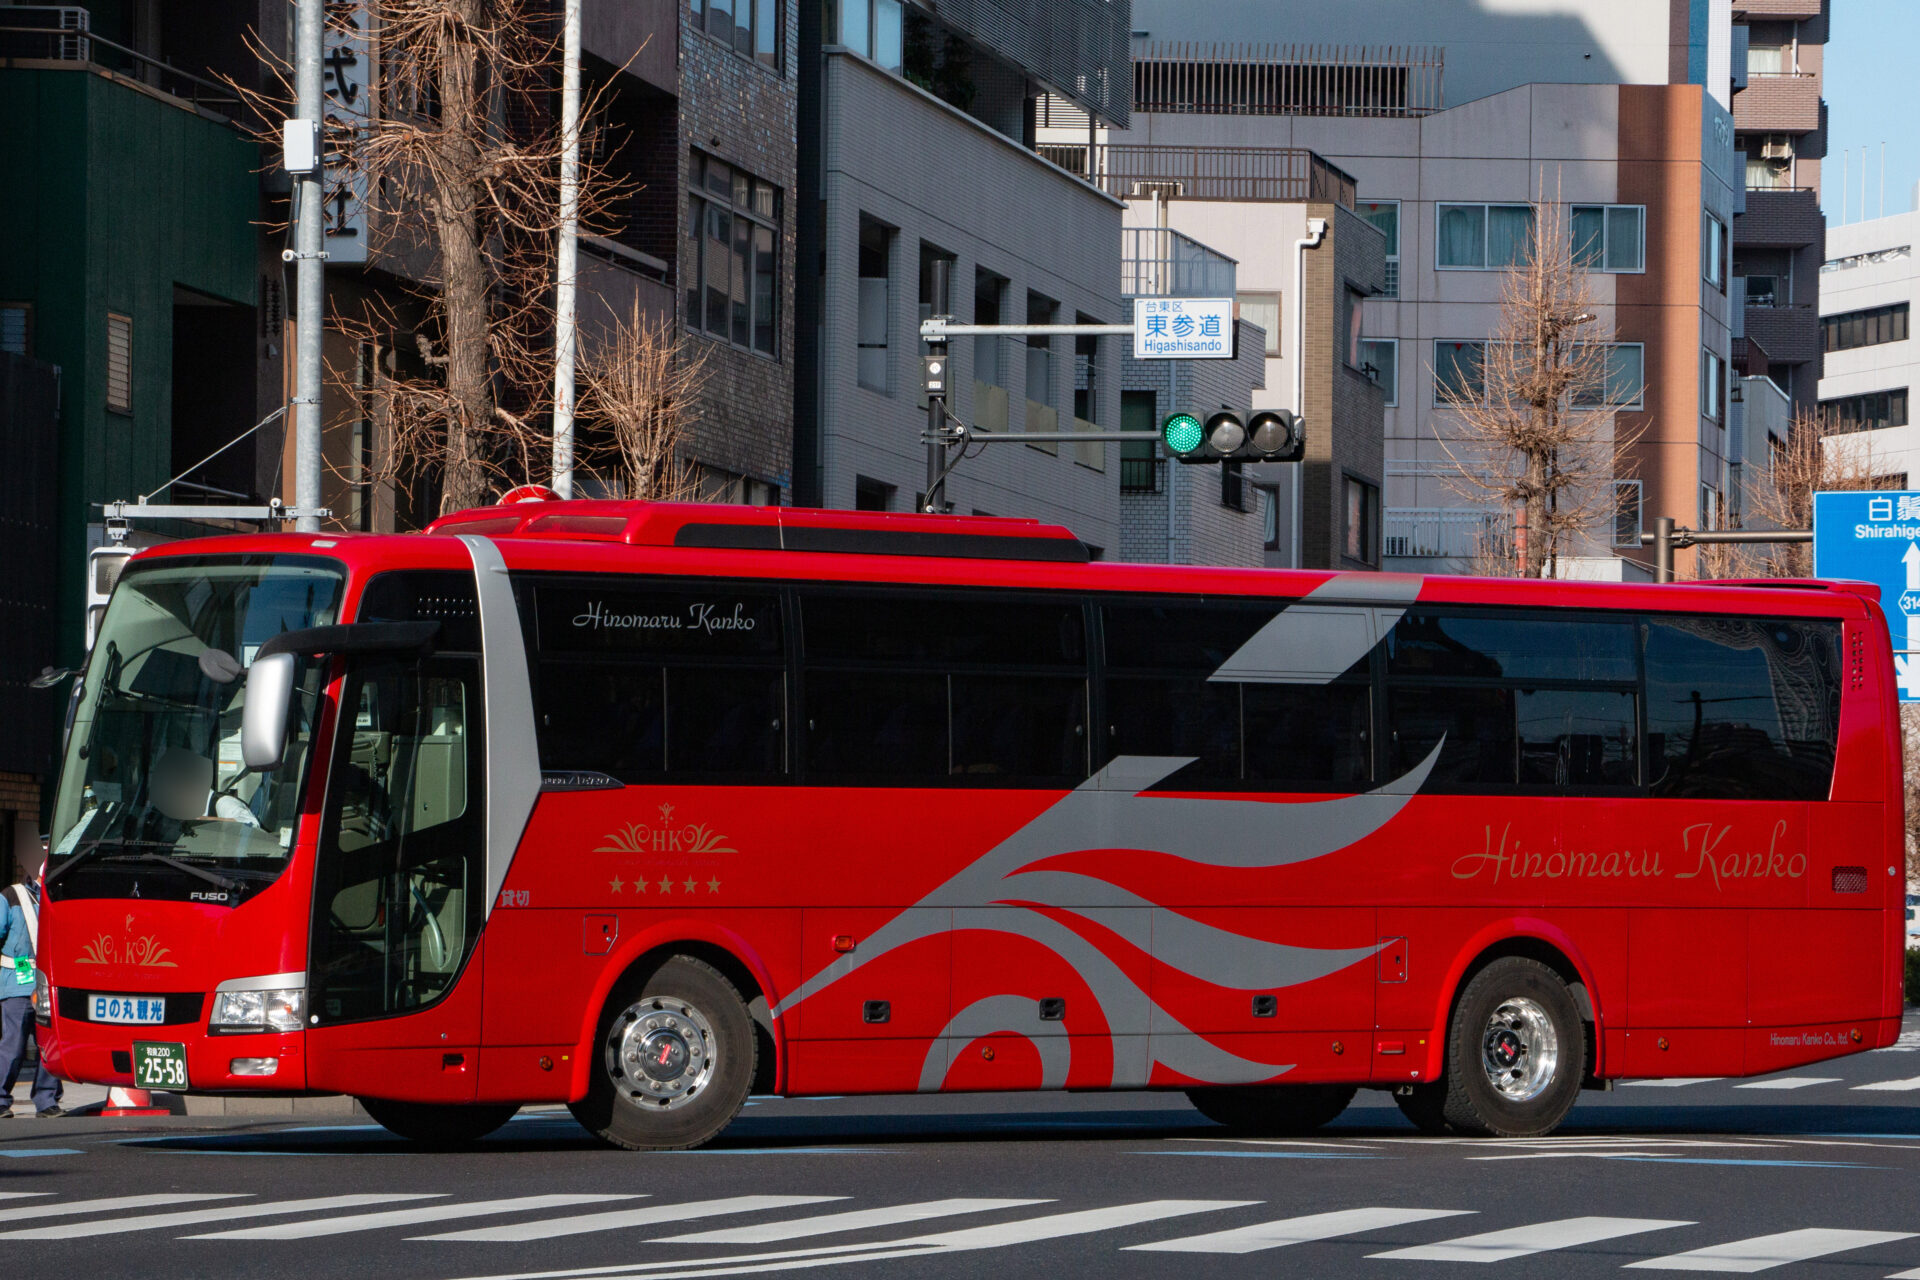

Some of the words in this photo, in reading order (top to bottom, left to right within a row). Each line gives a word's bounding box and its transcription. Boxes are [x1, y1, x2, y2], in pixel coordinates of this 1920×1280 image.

[1145, 301, 1183, 313] 台東区
[1144, 314, 1222, 338] 東参道
[1144, 339, 1222, 354] Higashisando
[572, 601, 683, 630] Hinomaru
[686, 602, 756, 636] Kanko
[652, 829, 683, 852] HK
[1450, 821, 1665, 885] Hinomaru
[1674, 819, 1807, 893] Kanko
[190, 892, 228, 901] FUSO
[501, 889, 530, 907] 貸切
[95, 997, 163, 1022] 日の丸観光
[1770, 1032, 1801, 1046] Hinomaru
[1802, 1032, 1823, 1046] Kanko
[144, 1058, 185, 1085] 25-58
